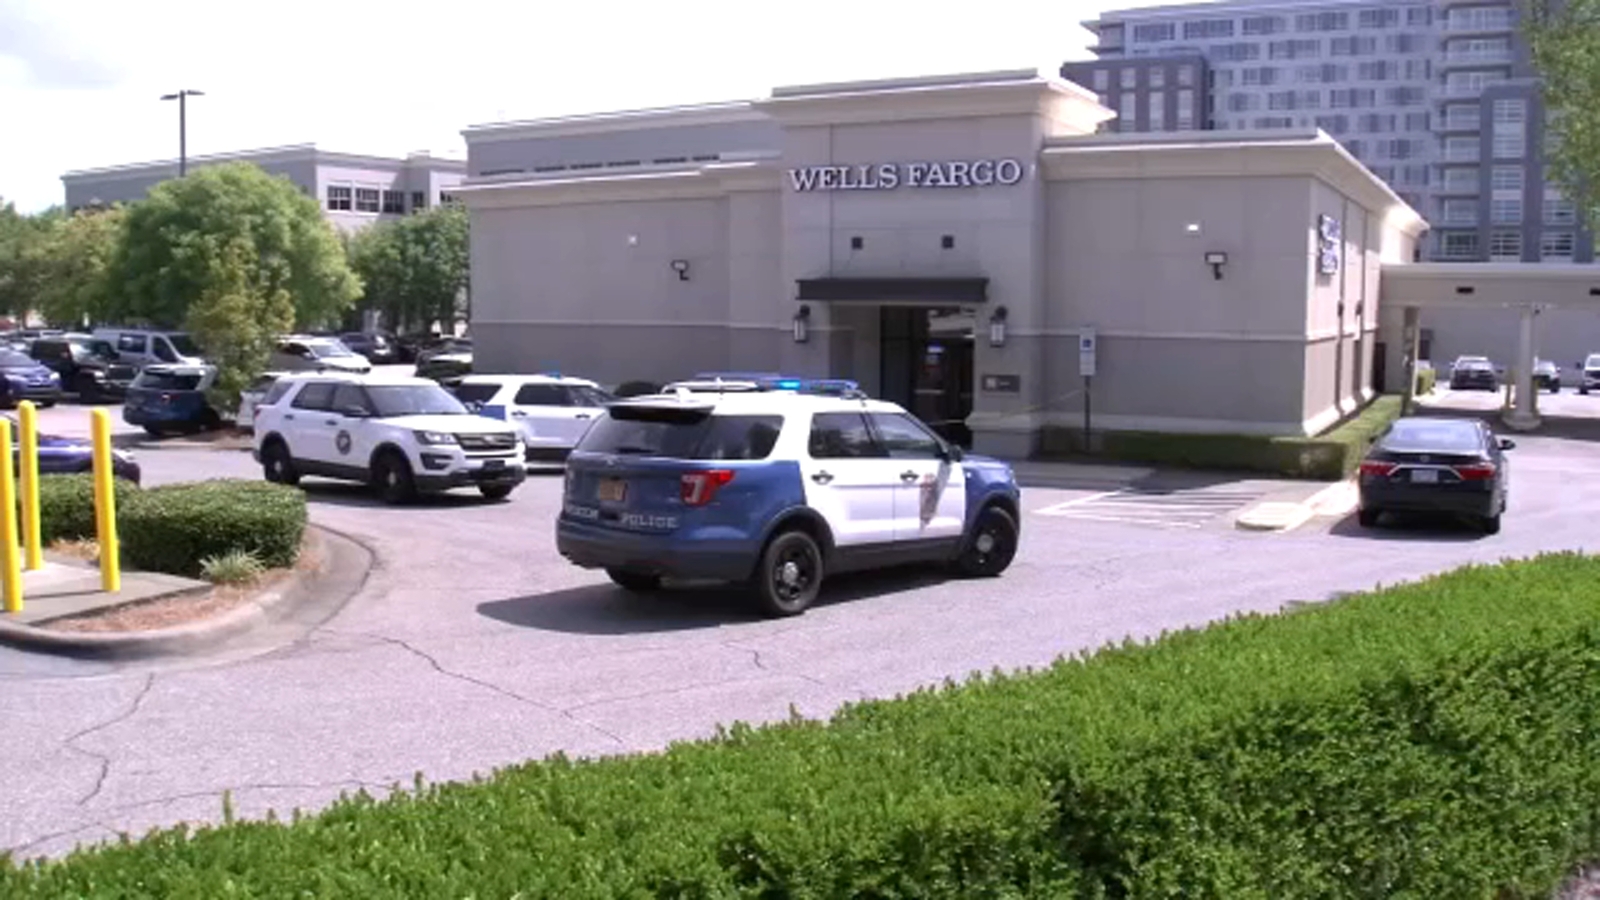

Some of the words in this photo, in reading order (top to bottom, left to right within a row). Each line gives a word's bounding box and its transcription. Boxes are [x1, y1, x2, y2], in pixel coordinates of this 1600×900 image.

[788, 164, 898, 191] WELLS
[906, 158, 1022, 187] FARGO
[621, 513, 678, 529] POLICE
